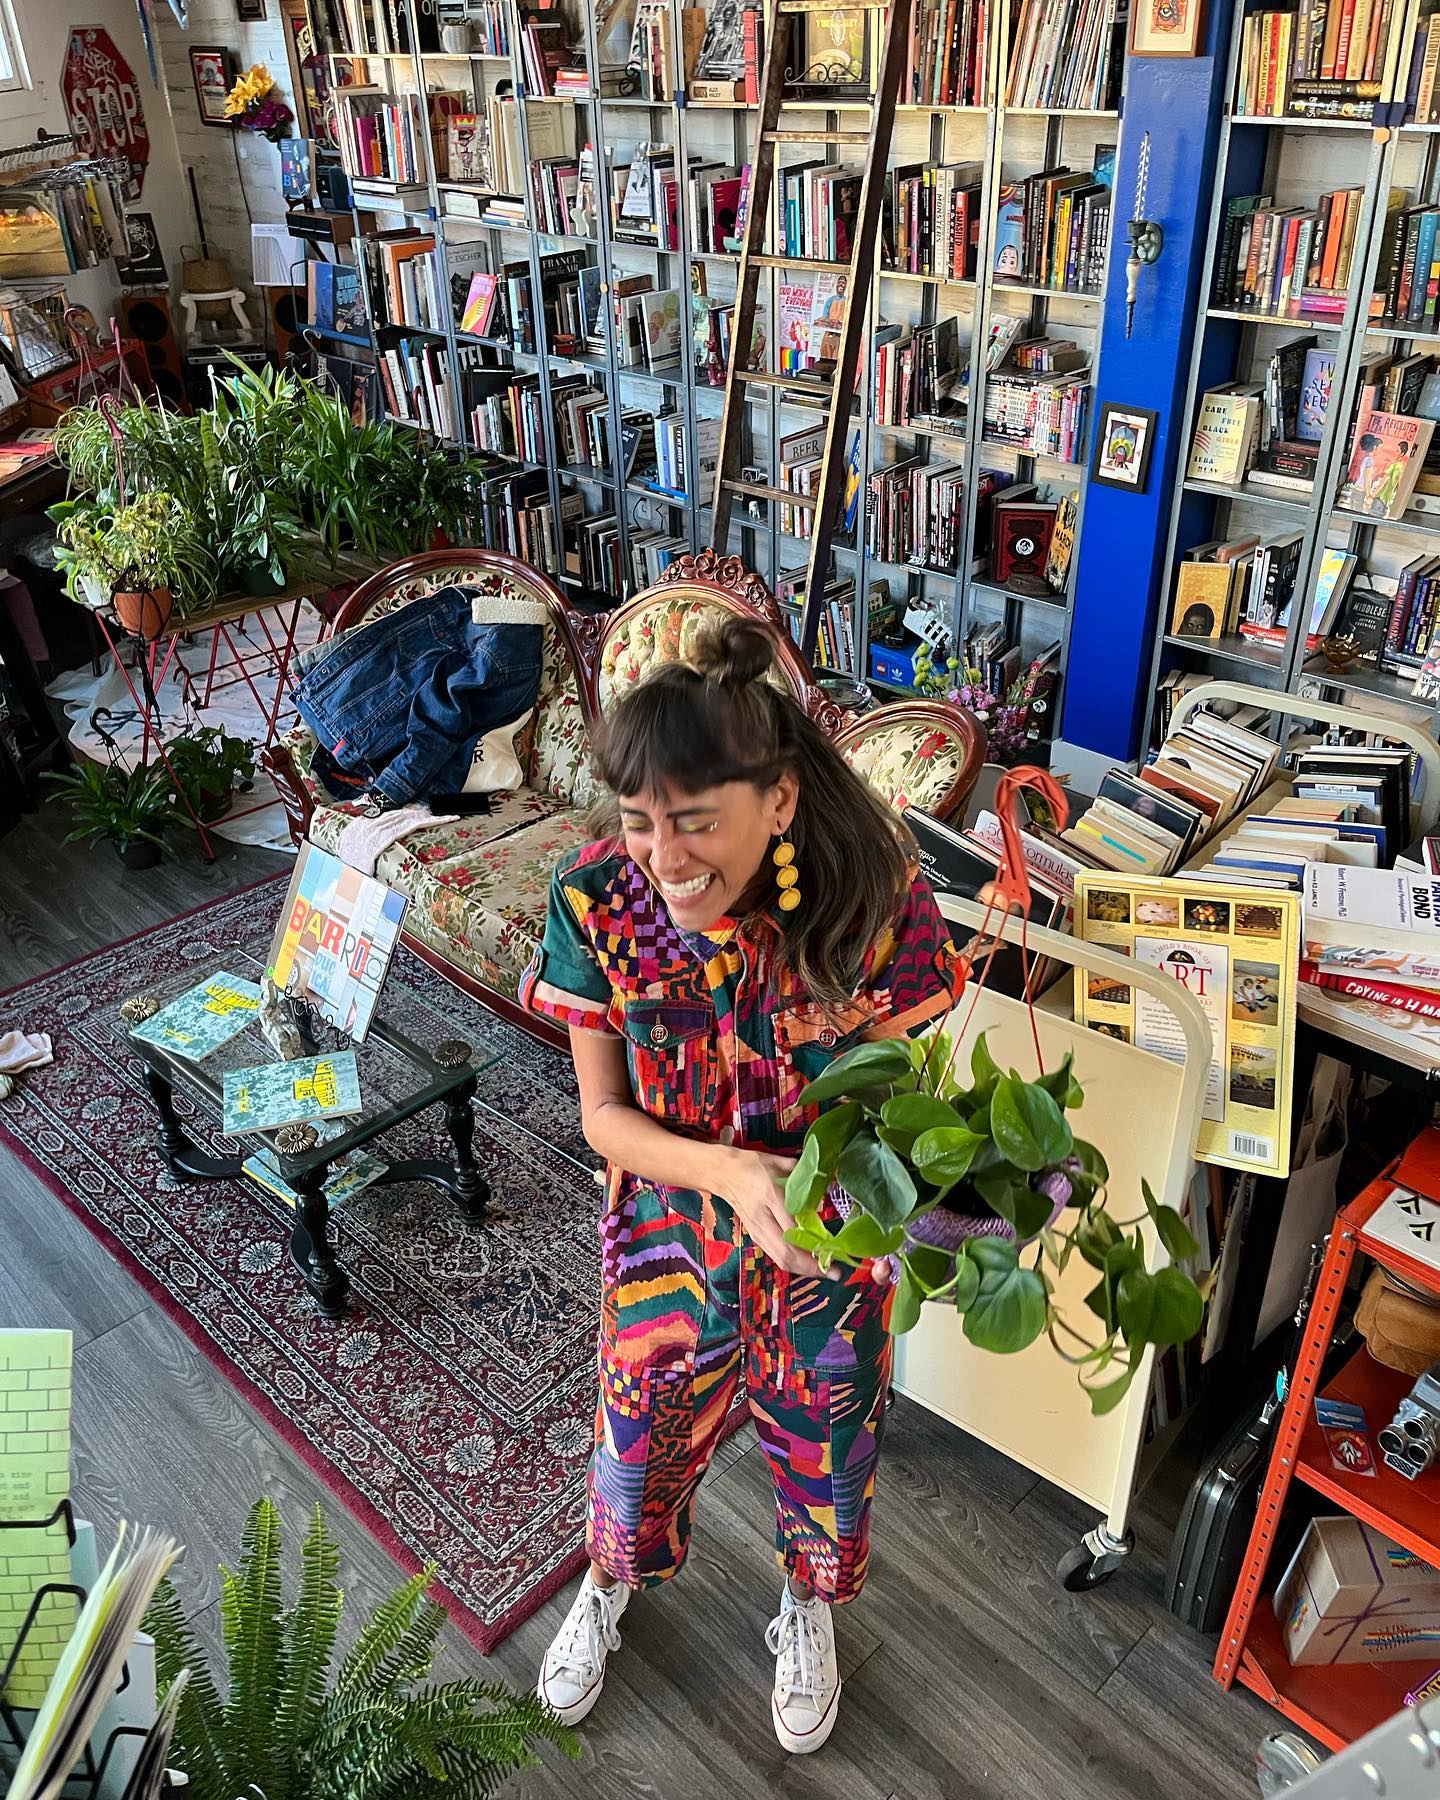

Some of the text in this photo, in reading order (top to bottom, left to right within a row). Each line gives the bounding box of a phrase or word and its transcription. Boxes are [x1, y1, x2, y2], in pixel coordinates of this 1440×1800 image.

[1260, 71, 1268, 101] BELIEVERS
[72, 83, 137, 153] STOP
[455, 252, 482, 262] ESCHER
[542, 254, 578, 269] FRANCE
[1404, 262, 1414, 287] RUST
[1205, 405, 1227, 414] CARE
[1203, 425, 1229, 434] BLACK
[1221, 417, 1241, 426] FREE
[1055, 527, 1072, 549] MARCH
[1352, 601, 1387, 617] MIDDLESE
[1024, 847, 1075, 881] ormulas
[1412, 886, 1431, 919] BOND
[289, 899, 383, 982] BARRIO
[1155, 942, 1181, 955] CHILD'S
[1182, 943, 1202, 955] BOOK
[1345, 982, 1391, 1002] CRYING
[1391, 997, 1404, 1006] IN
[1405, 999, 1419, 1011] H
